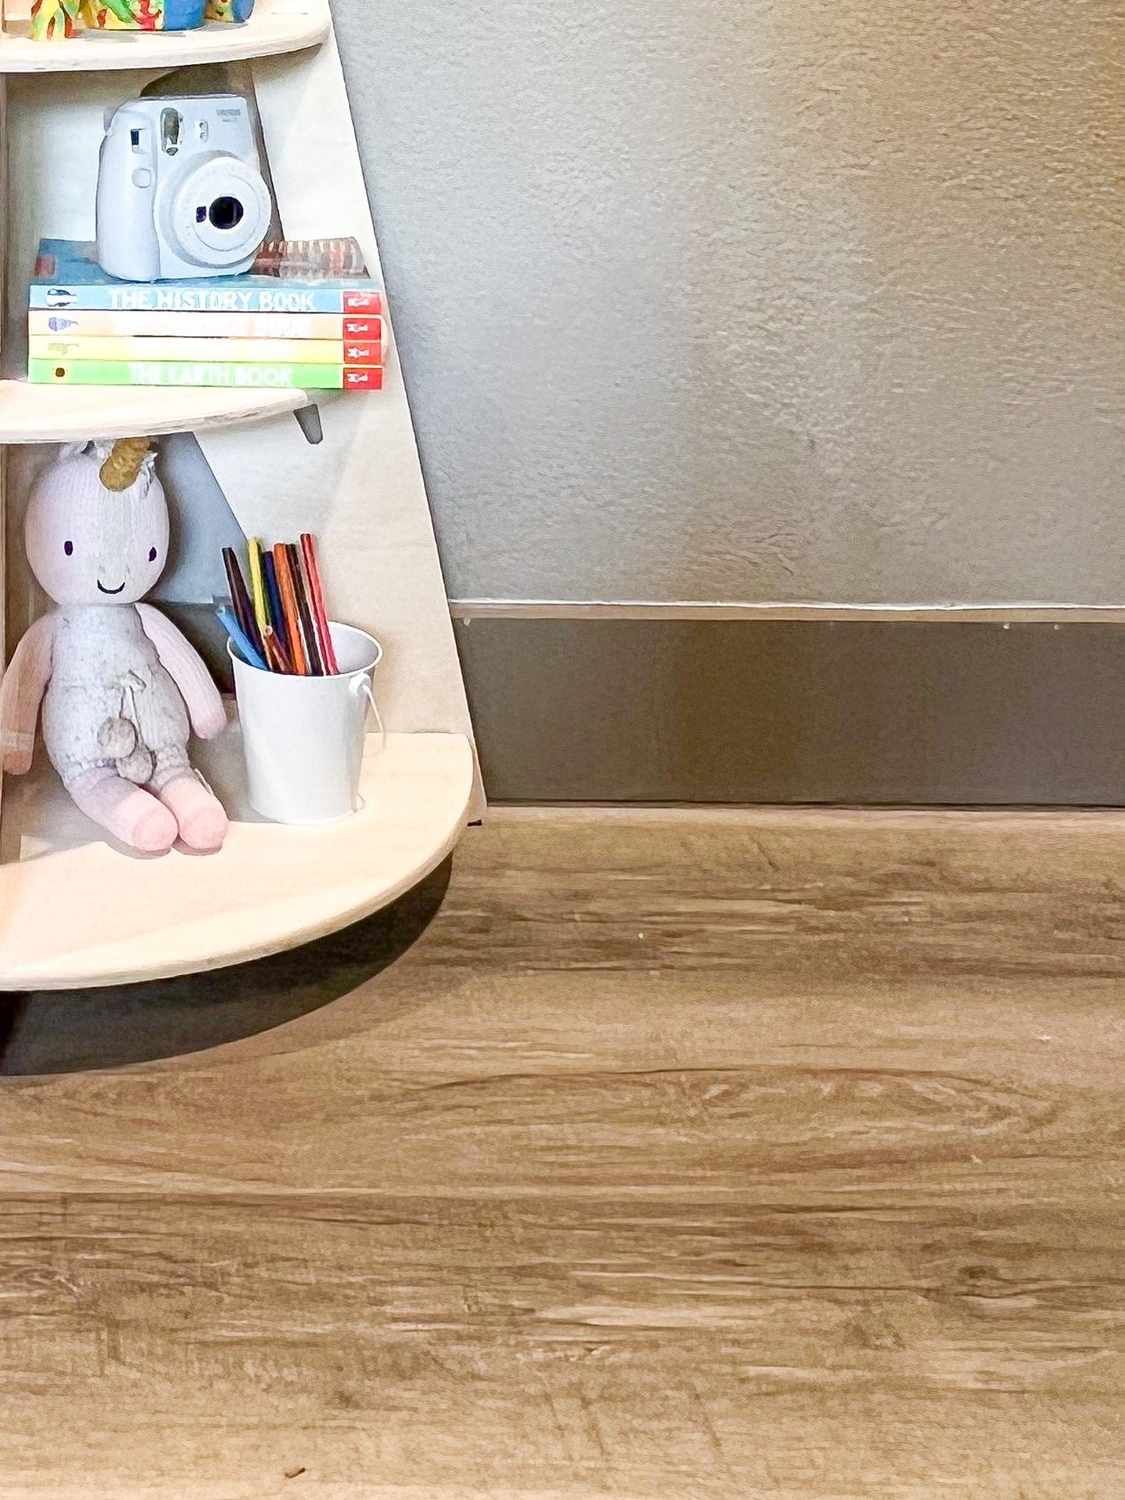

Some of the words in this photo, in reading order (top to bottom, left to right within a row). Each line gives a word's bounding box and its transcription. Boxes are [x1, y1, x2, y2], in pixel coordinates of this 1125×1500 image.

[109, 288, 150, 308] THE
[157, 289, 252, 310] HISTORY
[259, 290, 315, 311] BOOK
[129, 363, 162, 383] THE
[169, 364, 229, 385] EARTH
[234, 366, 293, 387] BOOK
